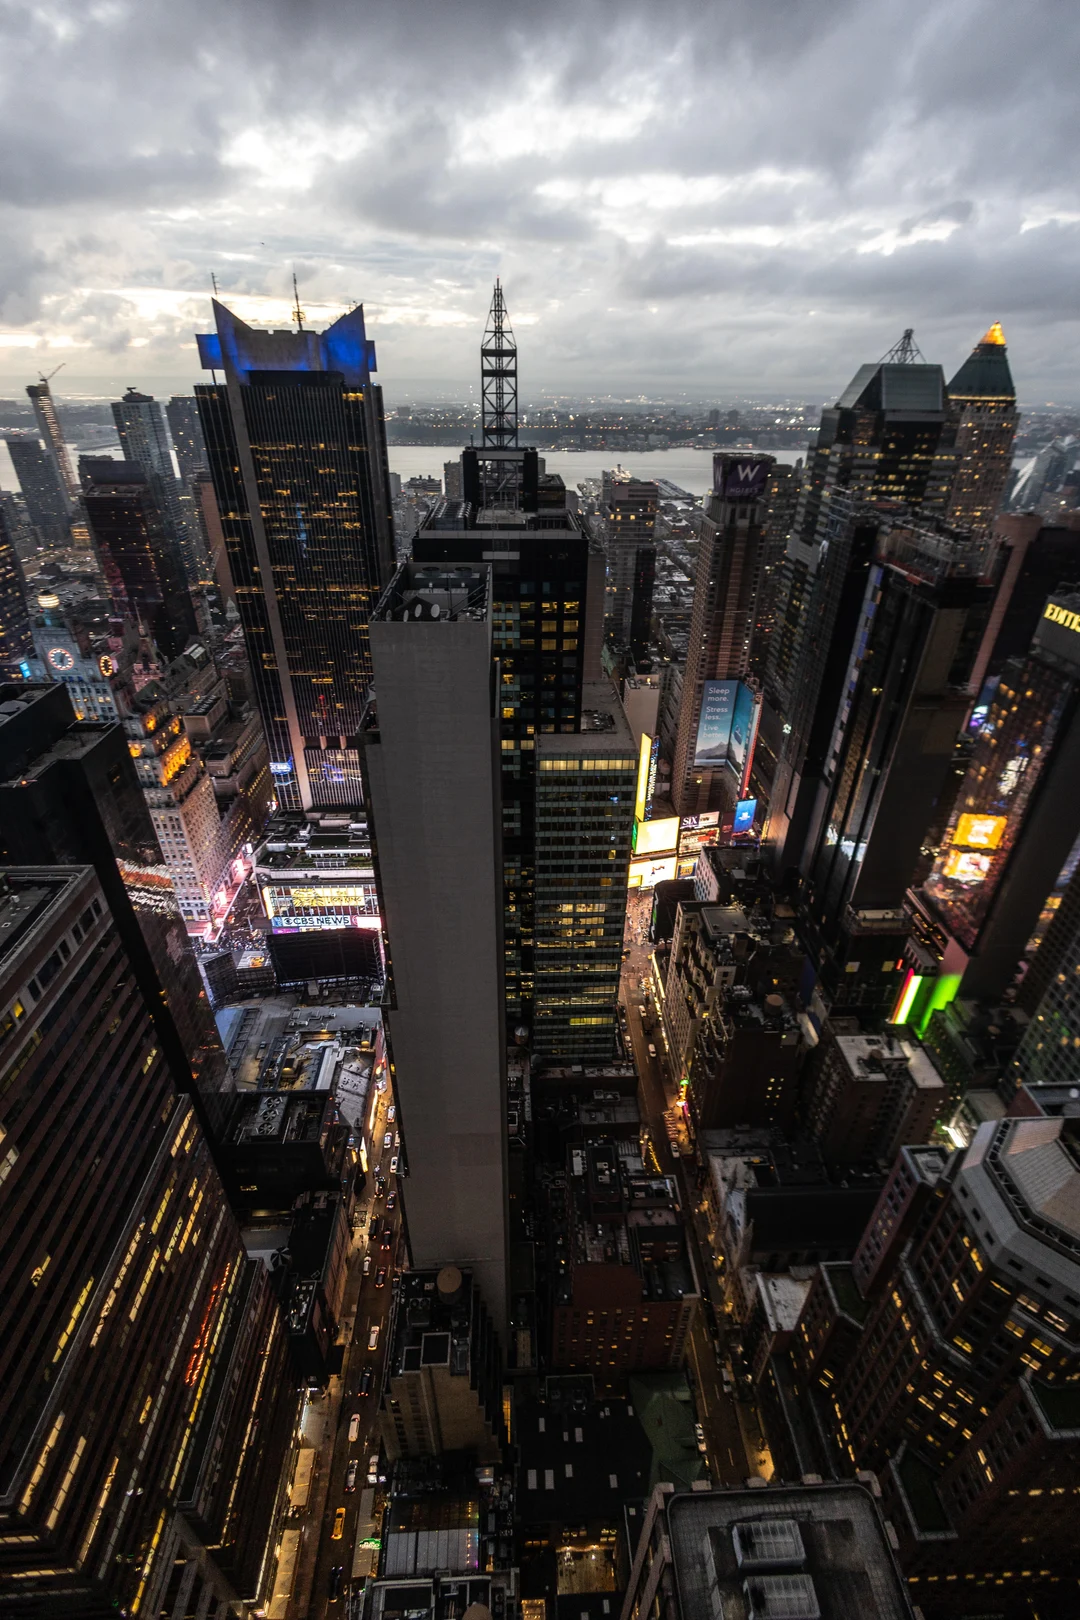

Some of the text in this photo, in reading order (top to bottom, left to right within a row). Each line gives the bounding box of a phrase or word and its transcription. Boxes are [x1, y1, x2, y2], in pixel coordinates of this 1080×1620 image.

[737, 464, 760, 482] W
[708, 687, 730, 695] Sleep
[293, 917, 350, 925] CBS NEWS
